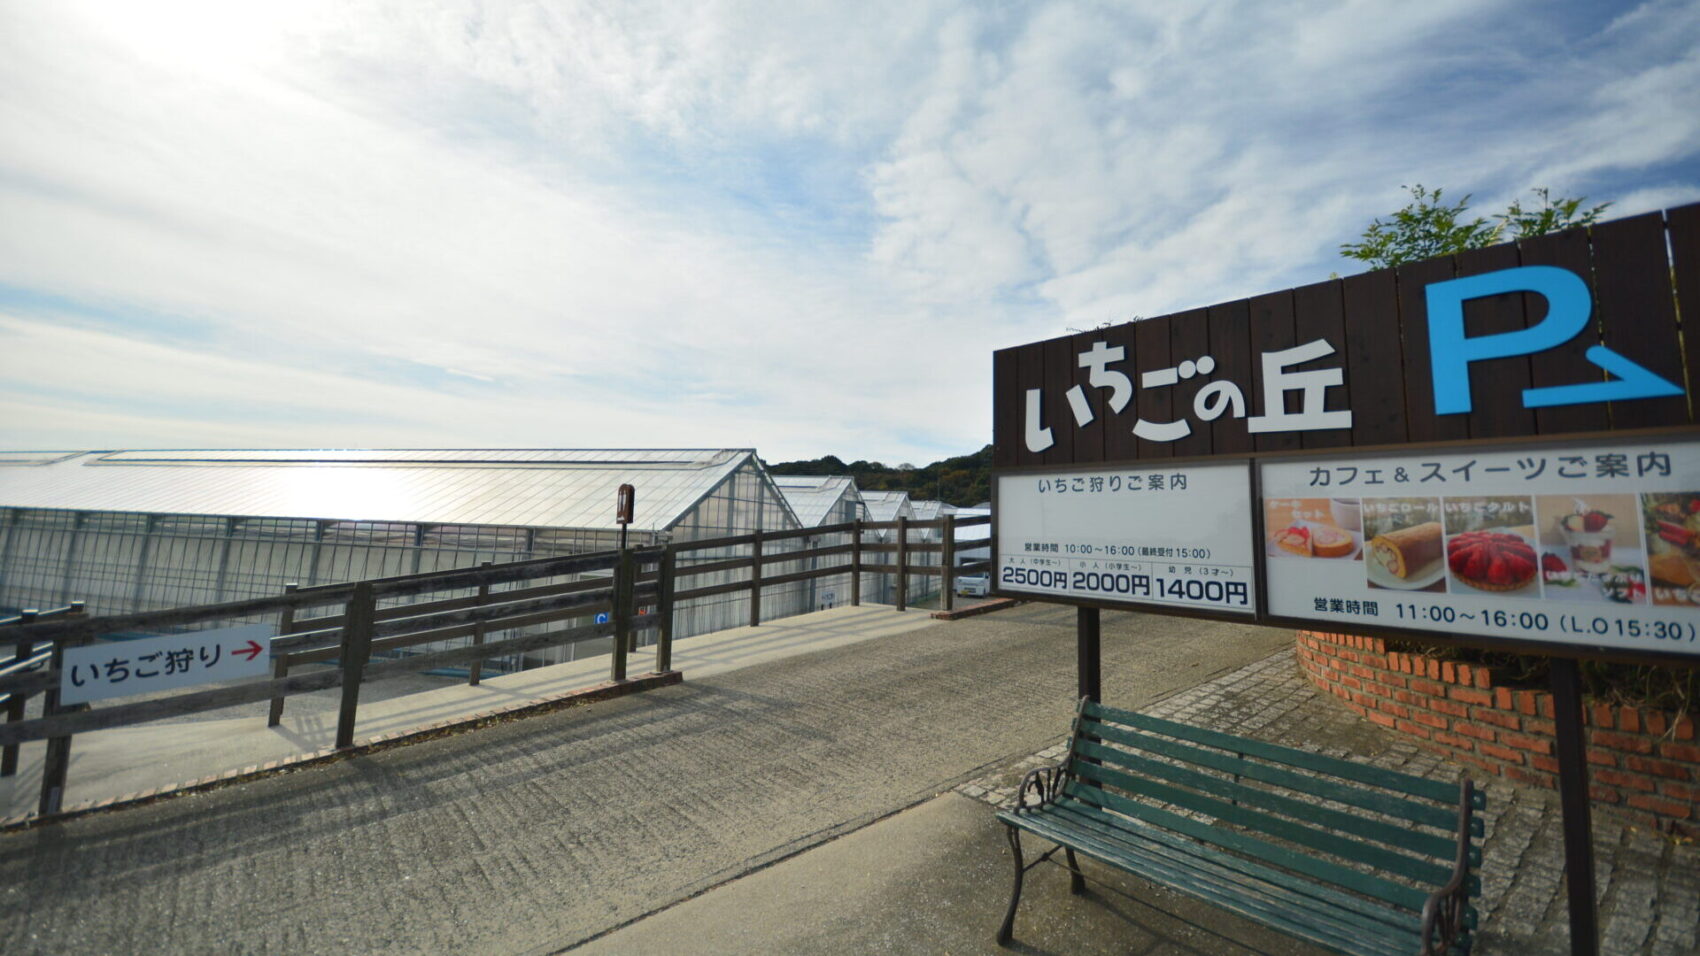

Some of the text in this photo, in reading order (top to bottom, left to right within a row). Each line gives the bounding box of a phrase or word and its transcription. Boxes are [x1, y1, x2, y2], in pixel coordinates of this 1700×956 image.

[1424, 266, 1593, 416] P
[1024, 339, 1353, 453] いちごの丘
[1038, 473, 1188, 494] いちご狩りご案内
[1444, 501, 1532, 513] いちごタルト
[1024, 542, 1059, 554] 営業時間
[1002, 566, 1068, 590] 2500円
[1072, 571, 1151, 597] 2000円
[1156, 577, 1249, 605] 1400円
[1313, 597, 1379, 617] 営業時間
[71, 643, 222, 687] いちご狩り
